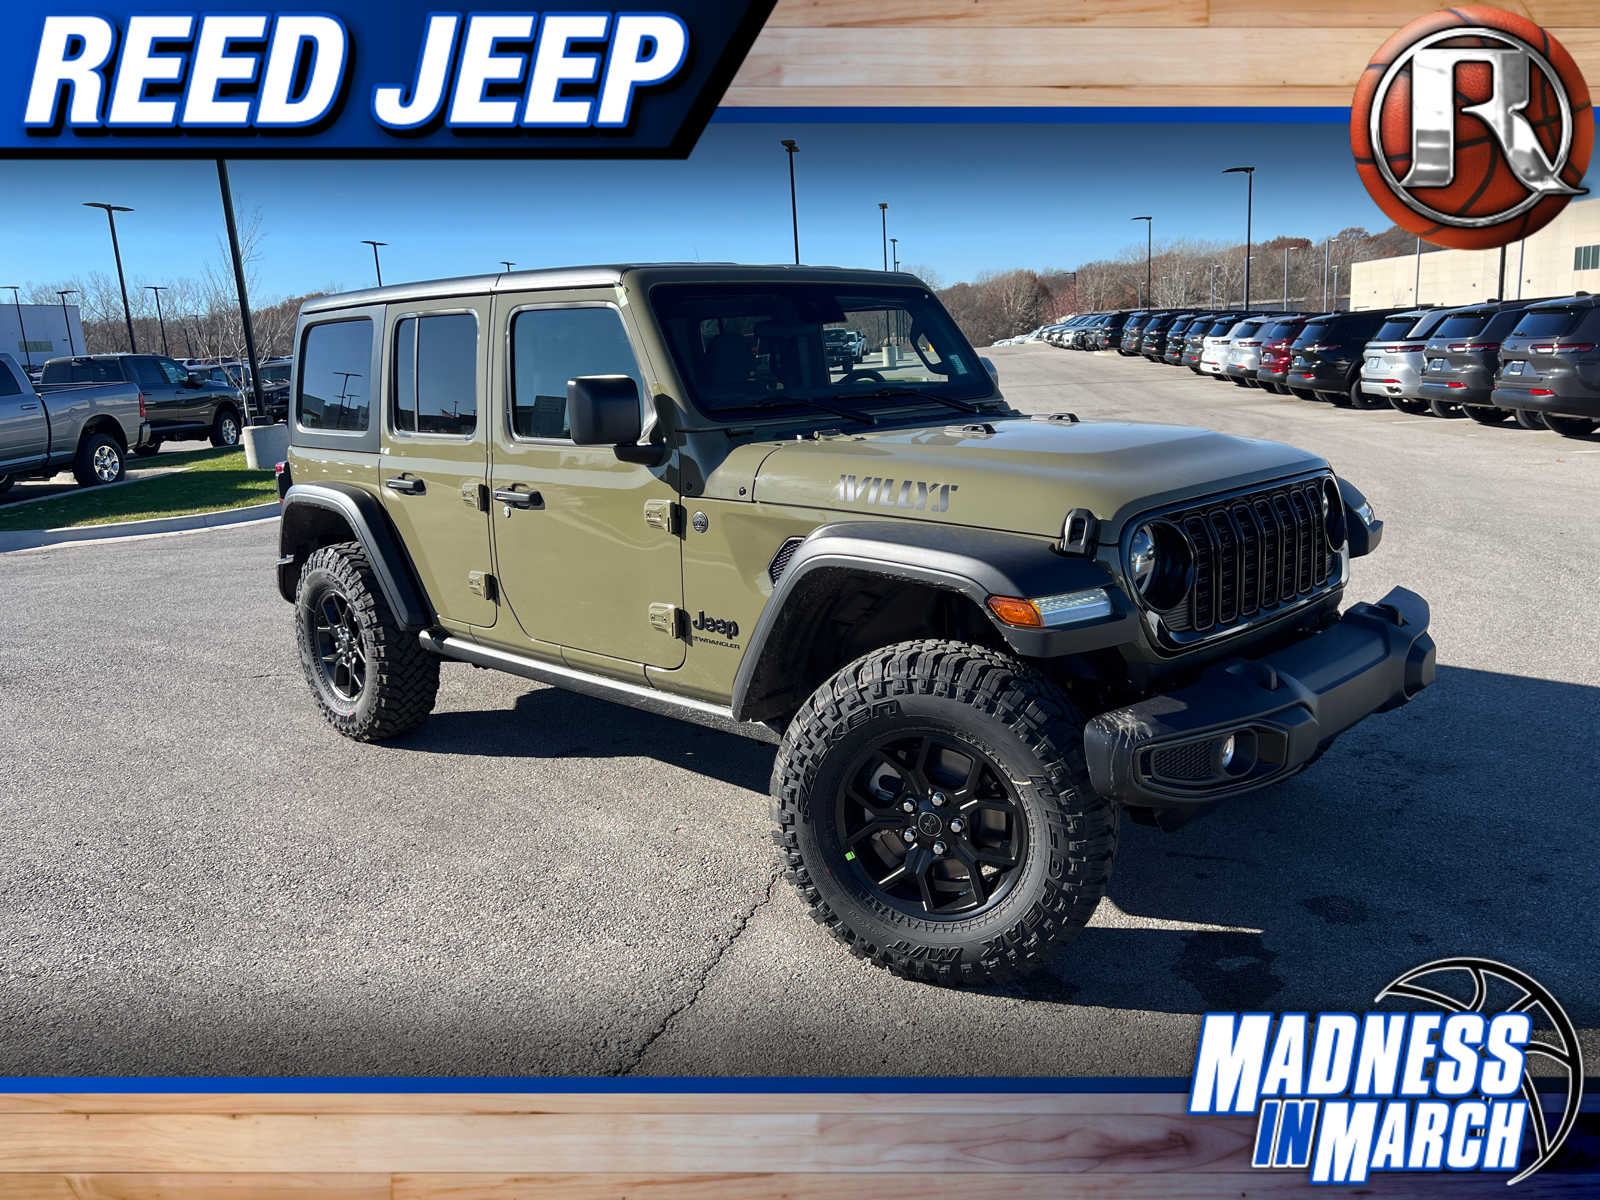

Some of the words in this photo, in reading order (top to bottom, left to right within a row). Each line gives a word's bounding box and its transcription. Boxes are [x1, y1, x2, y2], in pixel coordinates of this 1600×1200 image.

[839, 474, 959, 513] WILLYS
[692, 609, 740, 640] Jeep
[698, 636, 741, 649] WRANGLER
